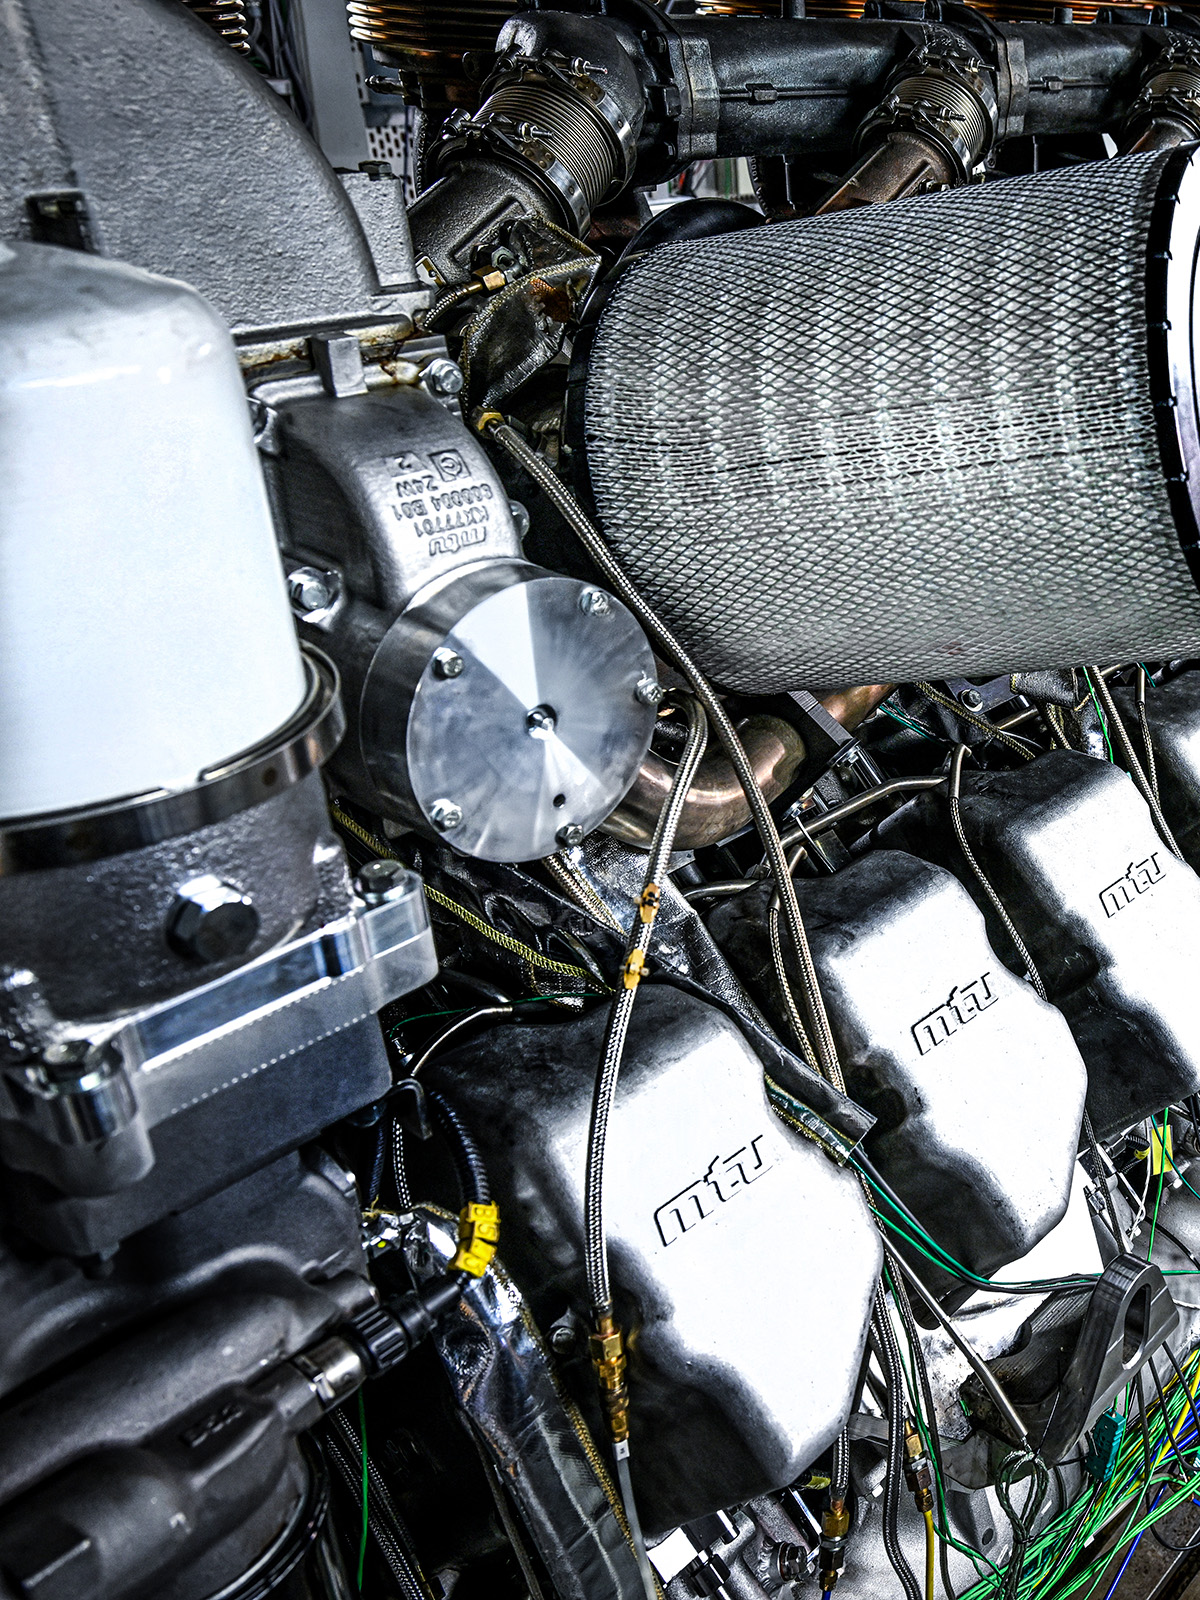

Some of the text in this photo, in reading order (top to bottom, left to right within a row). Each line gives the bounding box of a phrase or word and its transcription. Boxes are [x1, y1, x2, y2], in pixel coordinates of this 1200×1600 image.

[428, 526, 487, 556] mtu
[1099, 850, 1166, 918] mtu
[911, 972, 999, 1056] mtu
[653, 1135, 772, 1248] mtu
